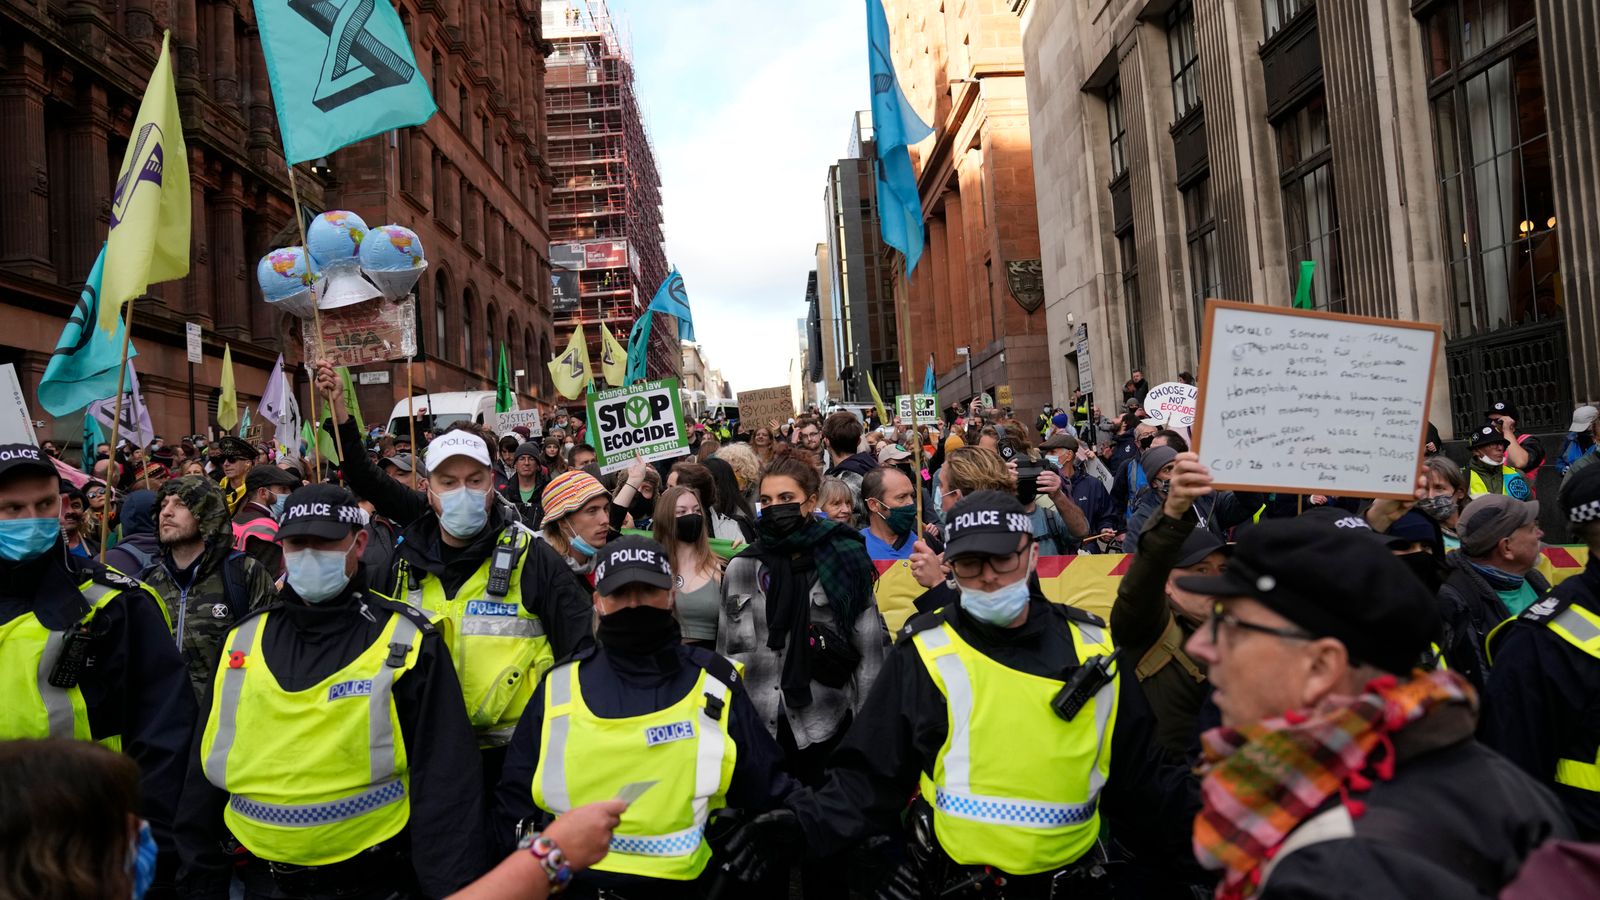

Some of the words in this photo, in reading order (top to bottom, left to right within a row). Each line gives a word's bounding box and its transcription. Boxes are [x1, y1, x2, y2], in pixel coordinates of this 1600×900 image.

[335, 331, 382, 351] USA
[598, 388, 628, 400] change
[629, 383, 644, 393] the
[645, 381, 662, 391] law
[738, 392, 757, 404] WHAT
[758, 390, 779, 401] WILL
[780, 387, 791, 398] BE
[1149, 385, 1185, 400] CHOOSE
[1187, 388, 1199, 400] LI
[900, 398, 935, 410] SOP
[1168, 396, 1187, 405] NOT
[752, 402, 781, 417] YOUR
[1160, 402, 1196, 416] ECOCIDE
[499, 412, 536, 425] SYSTEM
[440, 437, 482, 450] POLICE
[603, 422, 676, 452] ECOCIDE
[0, 449, 41, 461] OLICE
[606, 449, 634, 466] protect
[635, 447, 651, 457] the
[653, 440, 679, 452] earth
[1211, 459, 1243, 472] COP
[288, 502, 332, 520] POLICE
[954, 510, 1001, 532] POLICE
[610, 548, 656, 567] POLICE
[468, 600, 517, 616] POLICE
[330, 680, 372, 700] POLICE
[647, 722, 693, 745] POLICE
